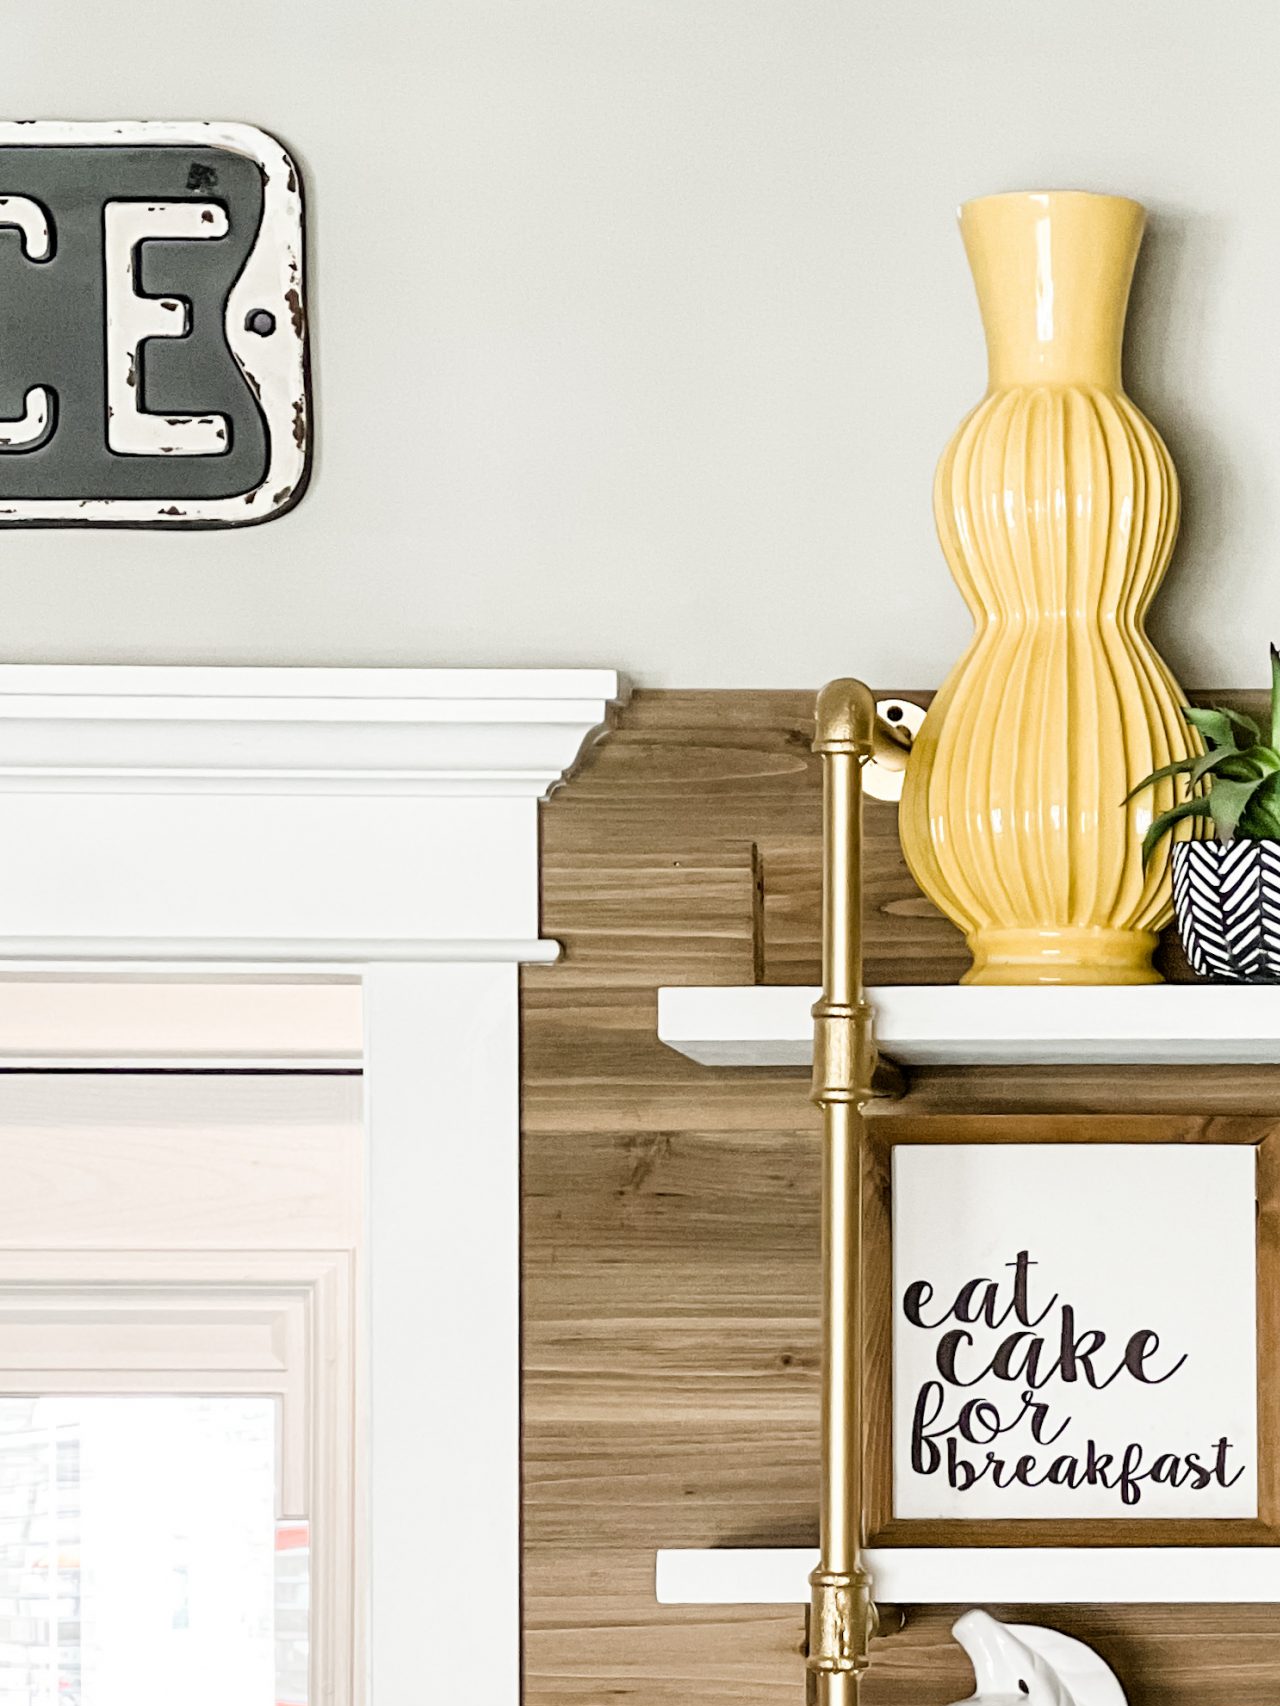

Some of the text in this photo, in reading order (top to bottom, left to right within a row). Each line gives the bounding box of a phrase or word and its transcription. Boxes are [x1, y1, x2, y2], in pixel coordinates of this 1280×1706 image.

[902, 1250, 1058, 1329] eat
[936, 1304, 1188, 1390] cake
[910, 1380, 1071, 1475] for
[946, 1436, 1245, 1506] breakfast
